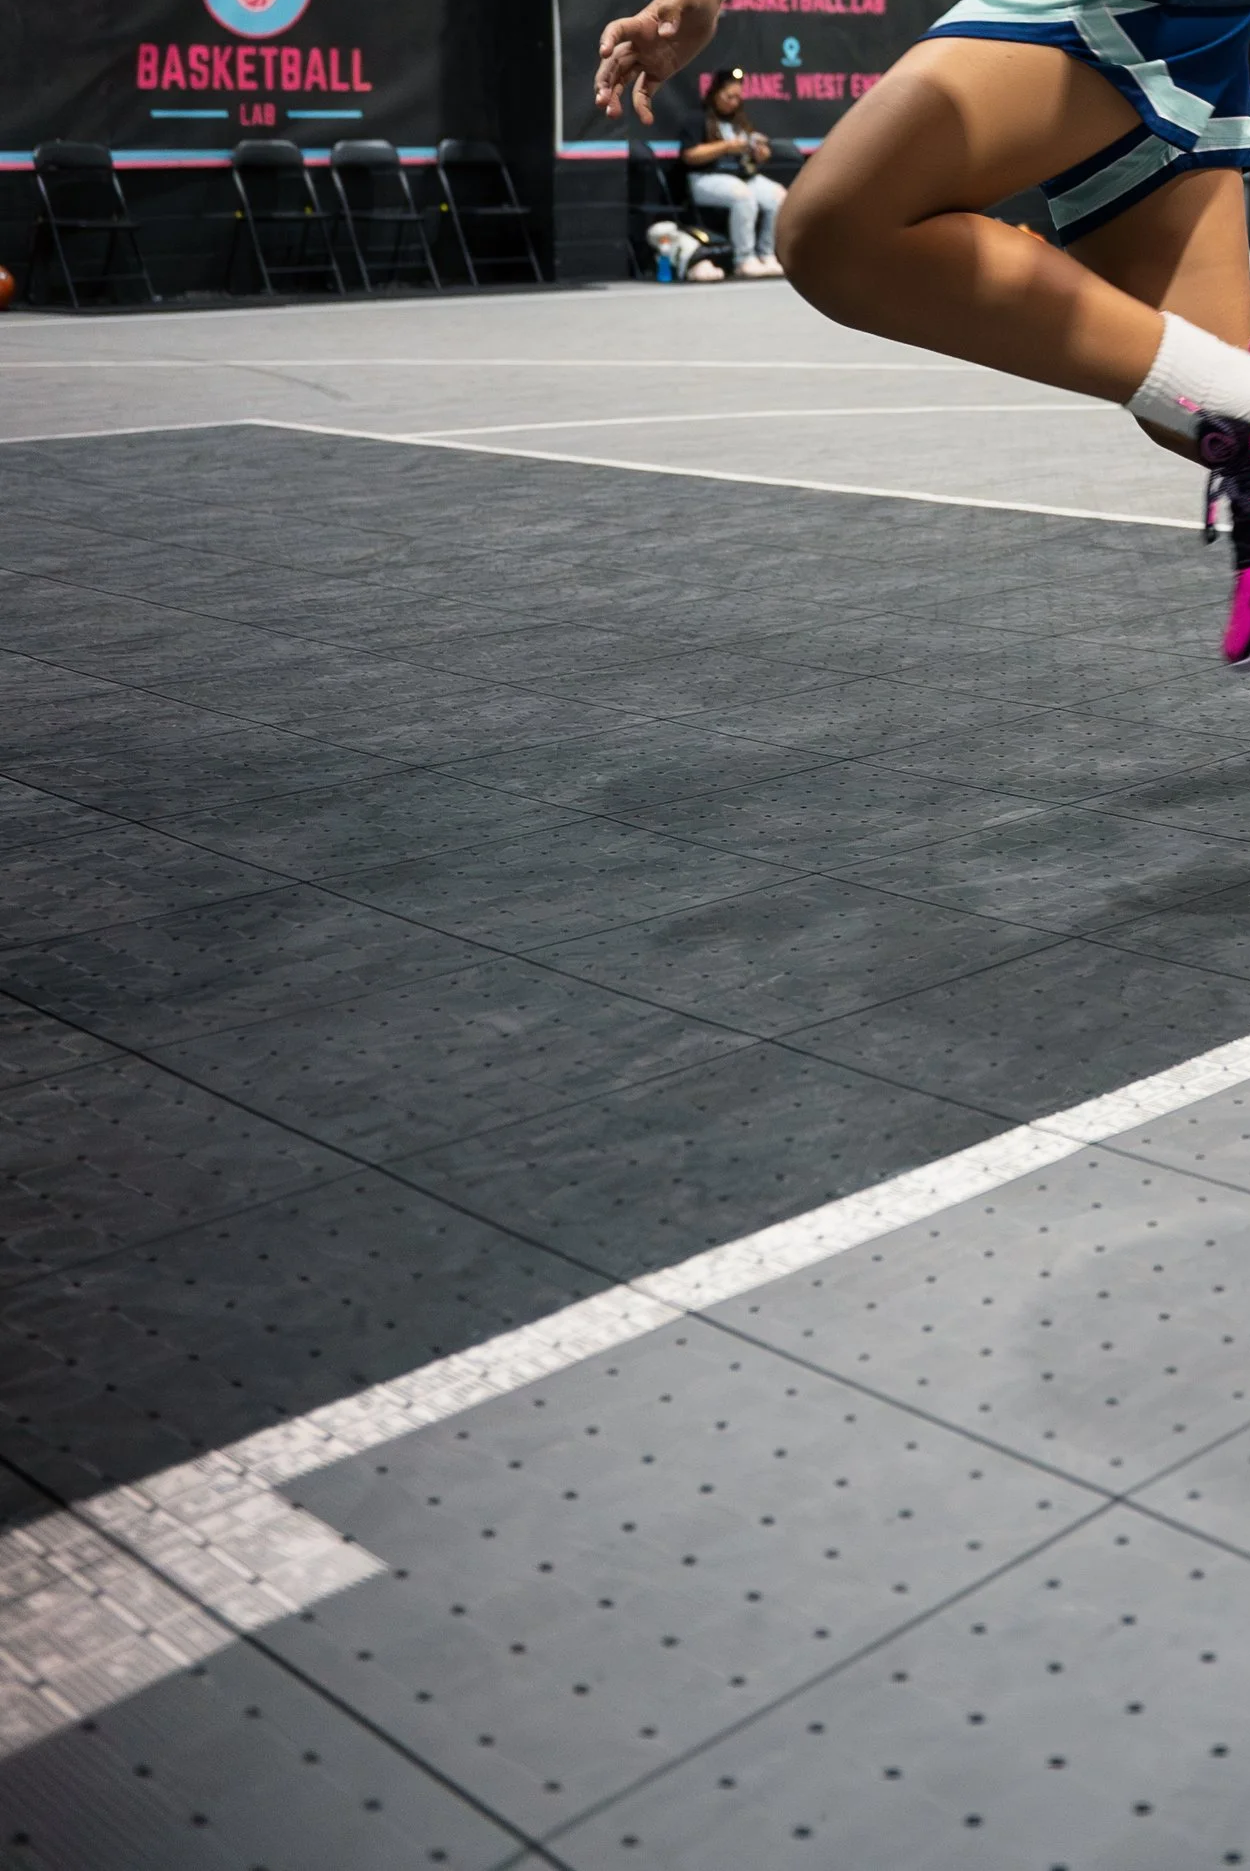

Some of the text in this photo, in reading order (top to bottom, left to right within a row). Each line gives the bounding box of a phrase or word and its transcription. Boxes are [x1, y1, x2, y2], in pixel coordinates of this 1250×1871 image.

[137, 43, 373, 92] BASKETBALL
[795, 73, 846, 100] WEST
[851, 74, 885, 100] EN
[239, 103, 276, 126] LAB
